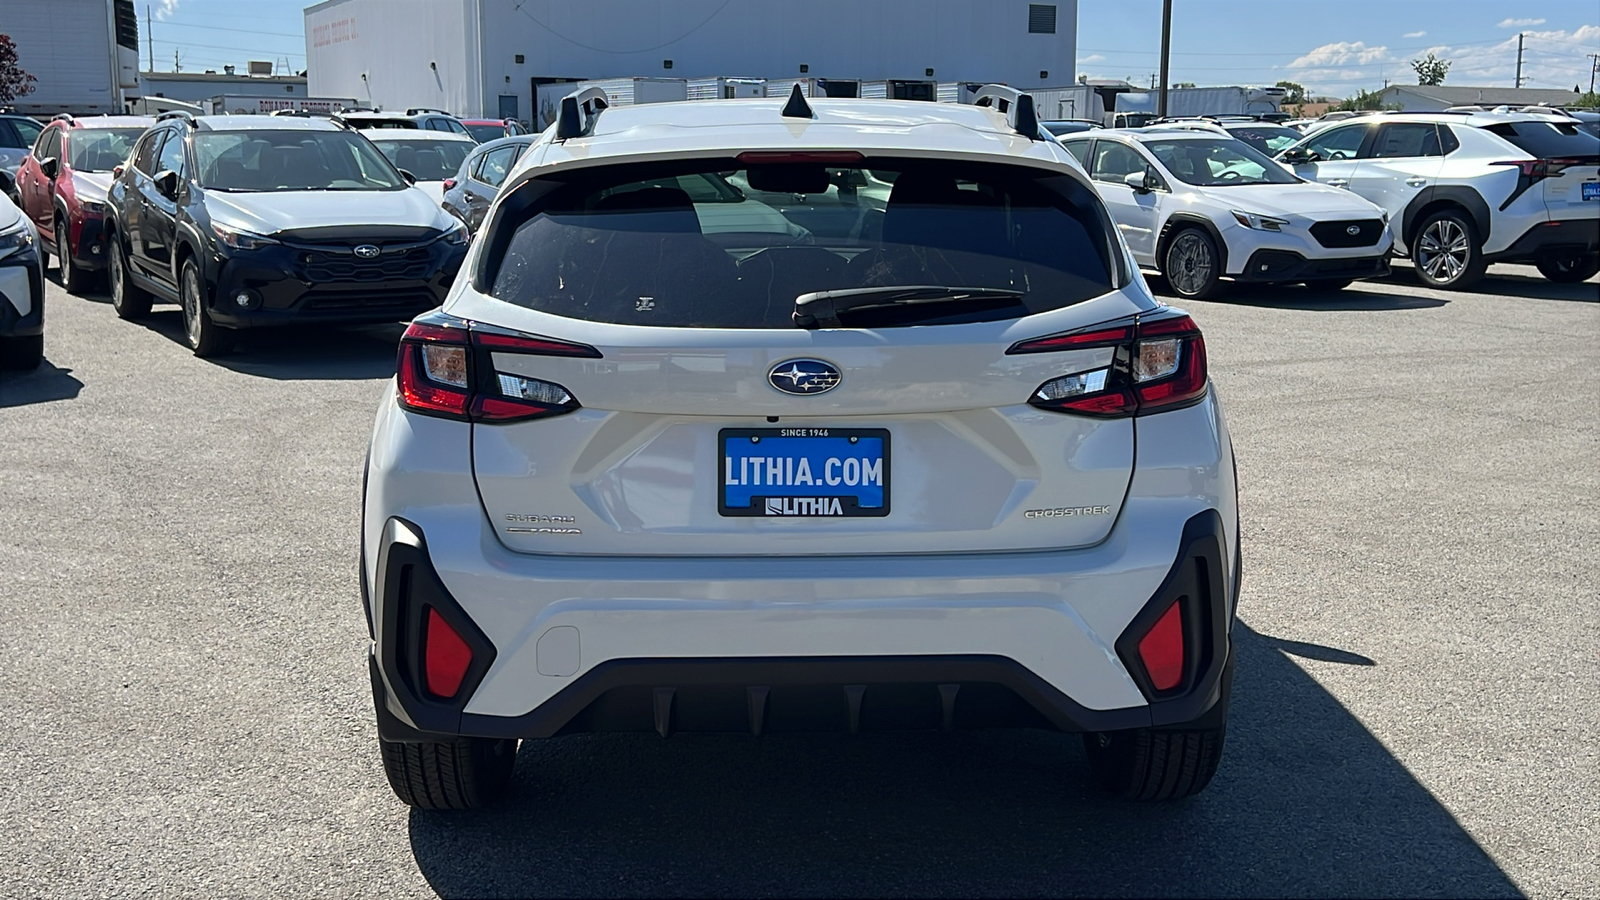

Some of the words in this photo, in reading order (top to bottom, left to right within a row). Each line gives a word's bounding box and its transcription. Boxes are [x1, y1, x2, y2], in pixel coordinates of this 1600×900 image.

[780, 429, 807, 437] SINCE
[809, 429, 829, 437] 1946
[725, 456, 883, 486] LITHIA.COM
[783, 497, 844, 515] LITHIA
[1024, 504, 1111, 519] CROSSTREK
[505, 513, 576, 524] SUBARU
